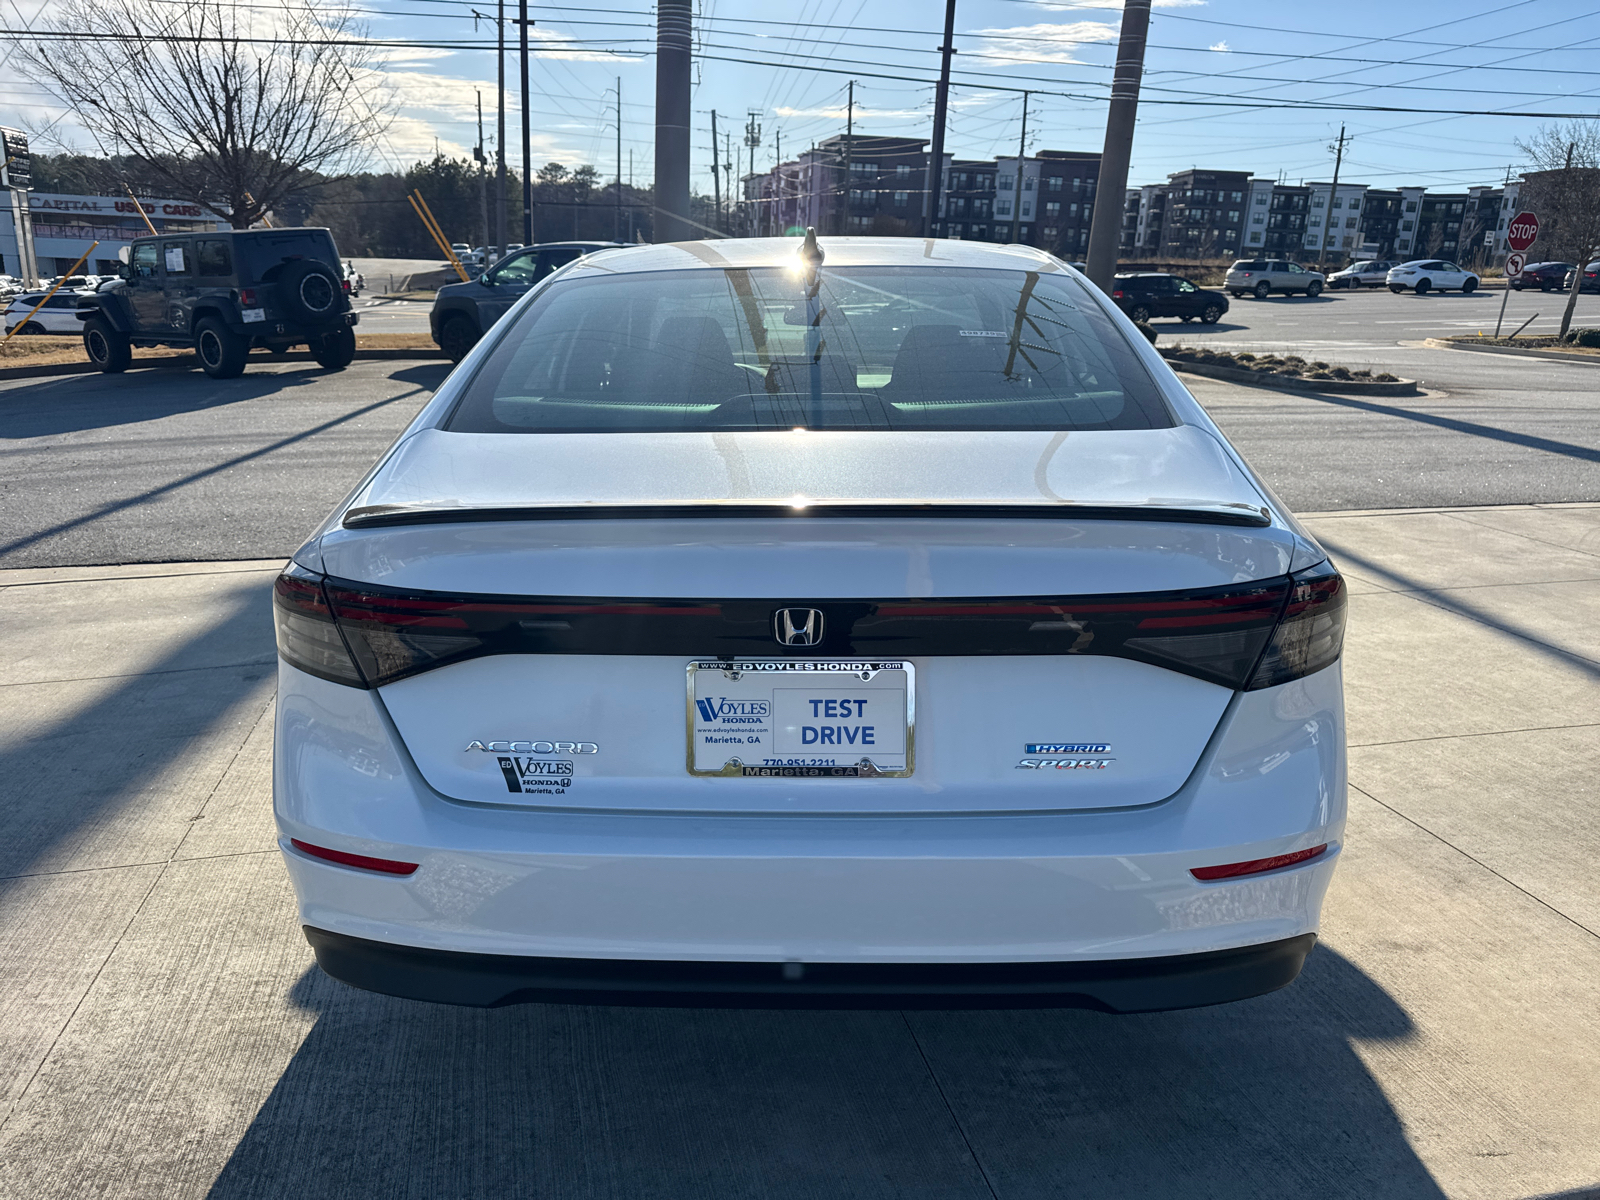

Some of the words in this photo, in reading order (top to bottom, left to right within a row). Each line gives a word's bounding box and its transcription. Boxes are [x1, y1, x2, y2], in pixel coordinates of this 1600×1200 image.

[163, 204, 202, 217] CARS
[1510, 223, 1537, 239] STOP
[705, 697, 767, 720] VOYLES
[809, 699, 868, 718] TEST
[705, 736, 744, 745] Marietta,
[747, 736, 761, 744] GA
[802, 726, 876, 745] DRIVE
[464, 740, 600, 755] ACCORD
[1038, 745, 1107, 753] HYBRID
[501, 760, 512, 769] ED
[514, 757, 572, 778] VOYLES
[1015, 758, 1117, 770] SPORT
[745, 767, 824, 777] Marietta,
[831, 767, 857, 777] GA
[525, 787, 554, 795] Marietta,
[555, 787, 566, 795] GA
